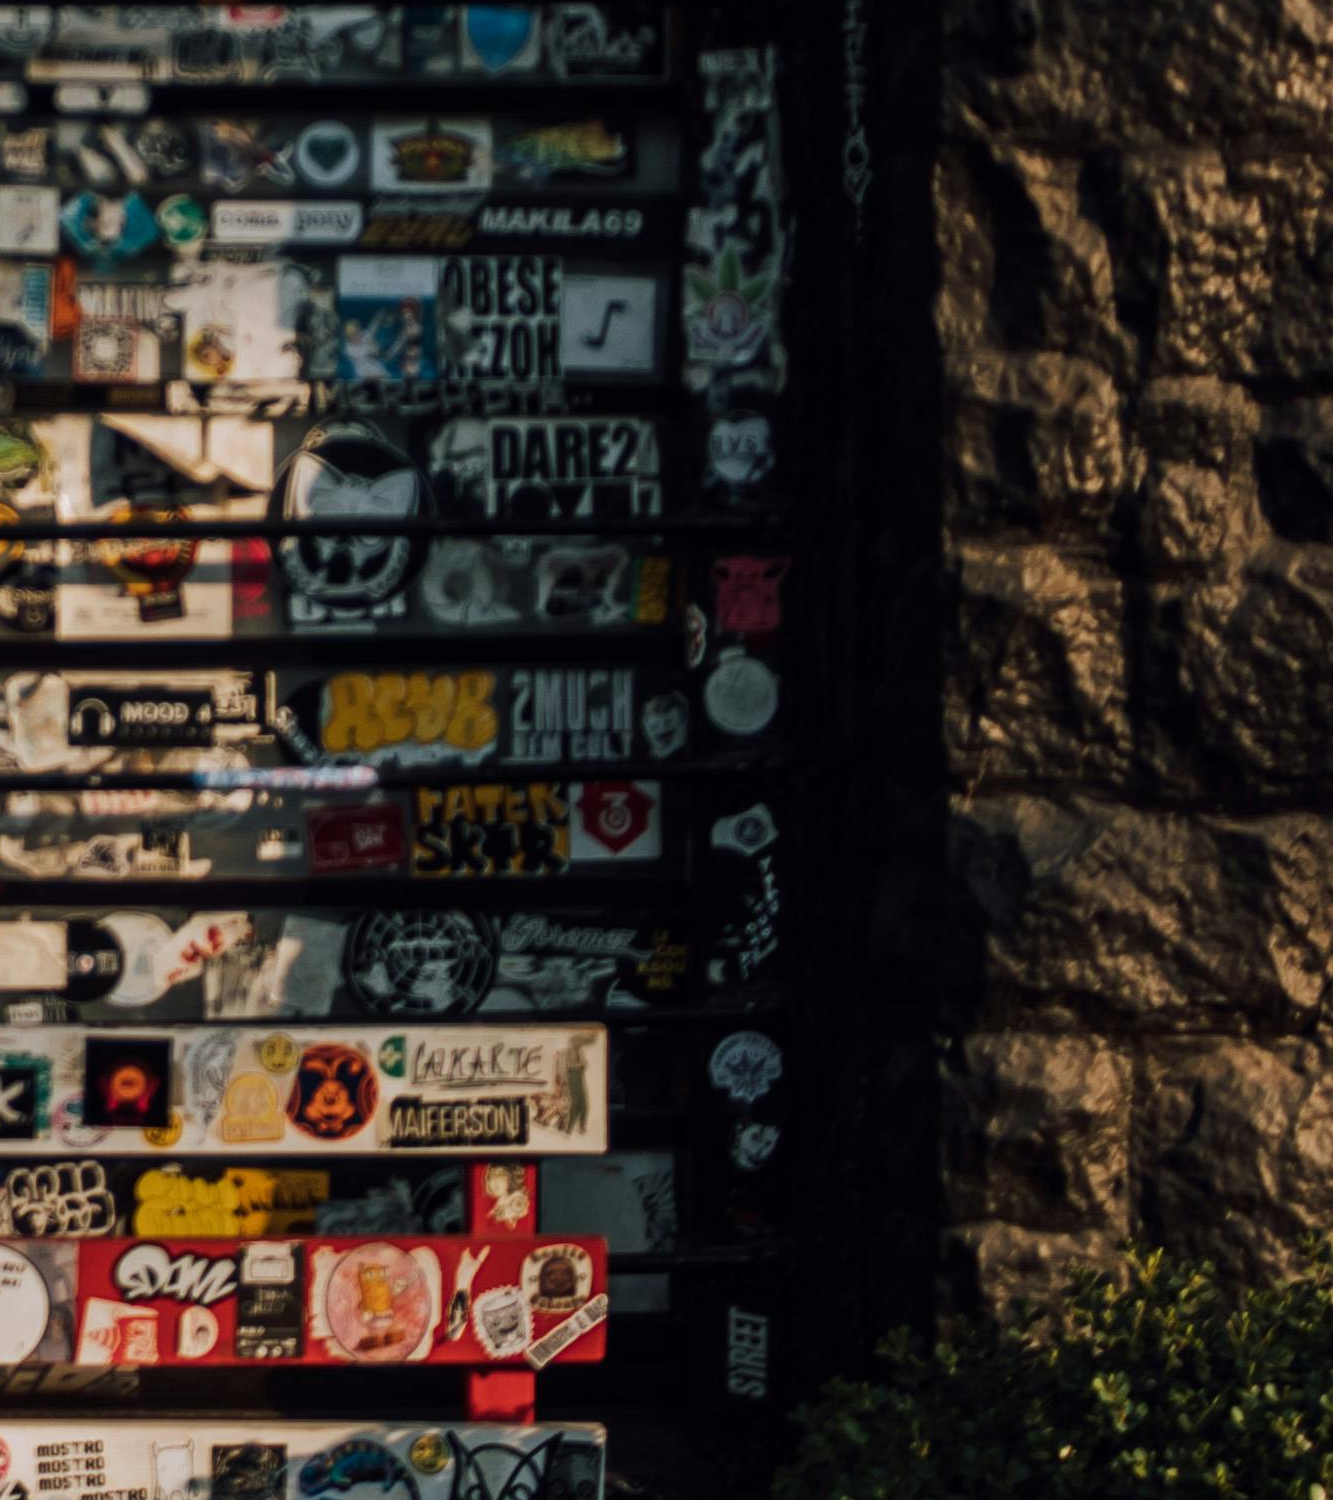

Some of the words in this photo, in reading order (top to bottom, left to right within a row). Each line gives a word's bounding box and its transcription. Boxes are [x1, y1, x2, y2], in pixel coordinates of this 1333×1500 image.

[36, 1439, 105, 1457] MOSTRO
[37, 1456, 106, 1473] MOSTRO
[38, 1473, 107, 1490] MOSTRO
